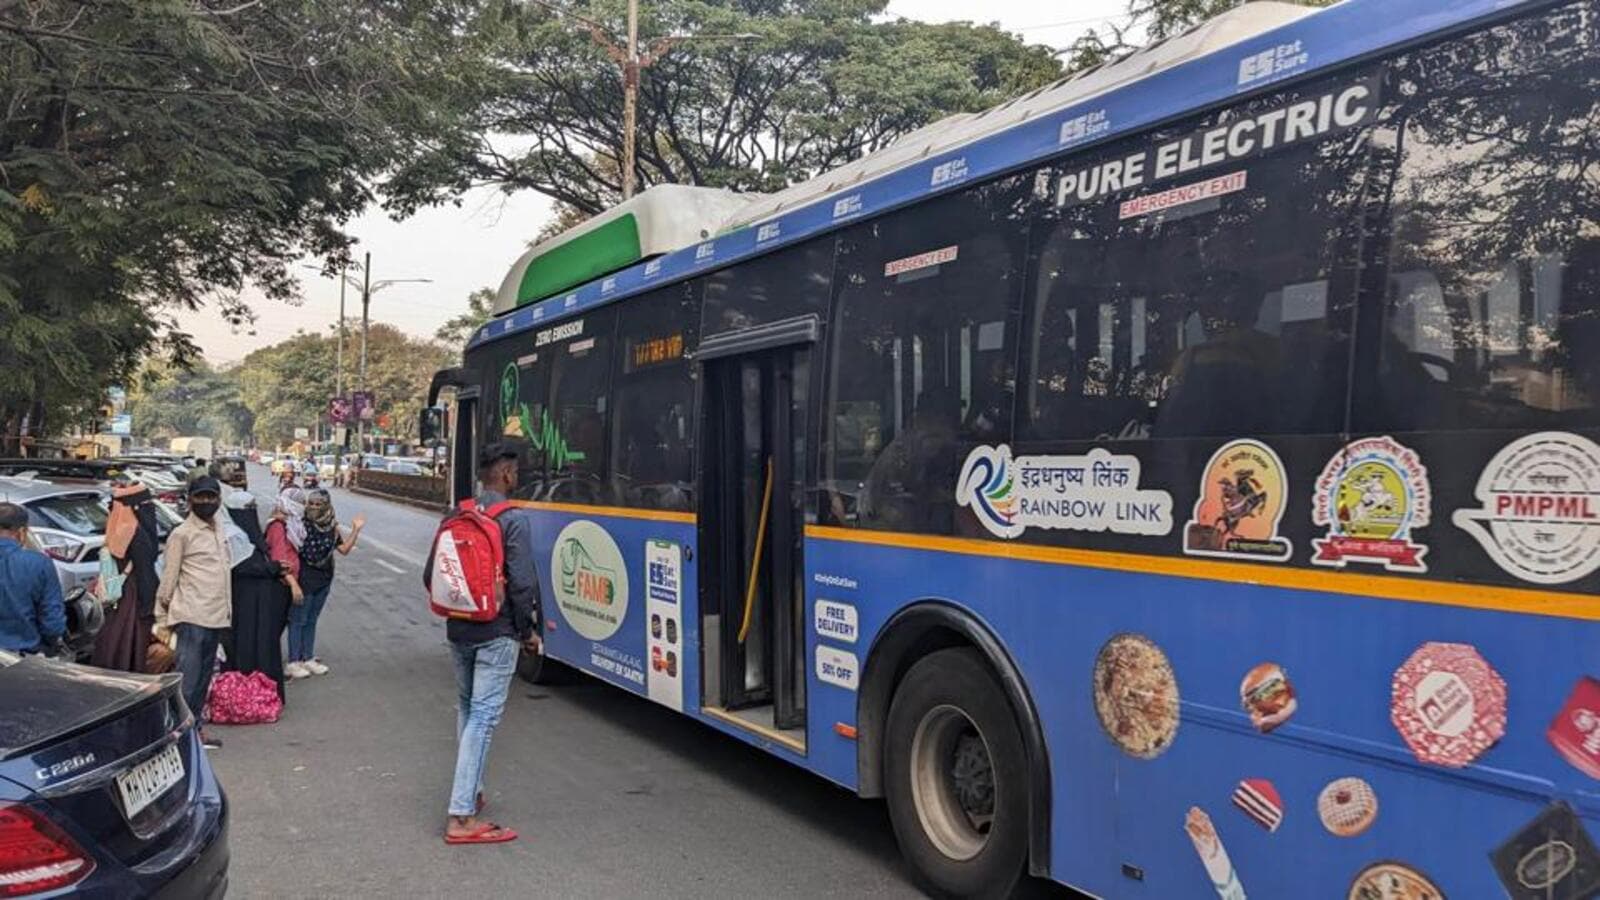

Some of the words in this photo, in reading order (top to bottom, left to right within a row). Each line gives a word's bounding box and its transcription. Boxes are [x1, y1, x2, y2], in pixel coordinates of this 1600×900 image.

[1277, 40, 1301, 58] Eat
[1274, 53, 1309, 73] Sure
[1087, 109, 1106, 124] Eat
[1086, 121, 1111, 136] Sure
[1057, 152, 1146, 206] PURE
[1155, 86, 1369, 179] ELECTRIC
[1120, 182, 1208, 217] EMERGENCY
[1210, 173, 1245, 196] EXIT
[886, 254, 936, 275] EMERGENCY
[937, 247, 957, 264] EXIT
[535, 329, 551, 347] ZERO
[552, 320, 584, 342] EMISSION
[1020, 461, 1086, 493] इंद्रधनुष्य
[1092, 461, 1131, 488] लिंक
[1020, 499, 1105, 518] RAINBOW
[1116, 503, 1161, 522] LINK
[1496, 495, 1597, 518] PMPML
[826, 606, 845, 620] FREE
[817, 617, 855, 637] DELIVERY
[836, 667, 854, 681] OFF
